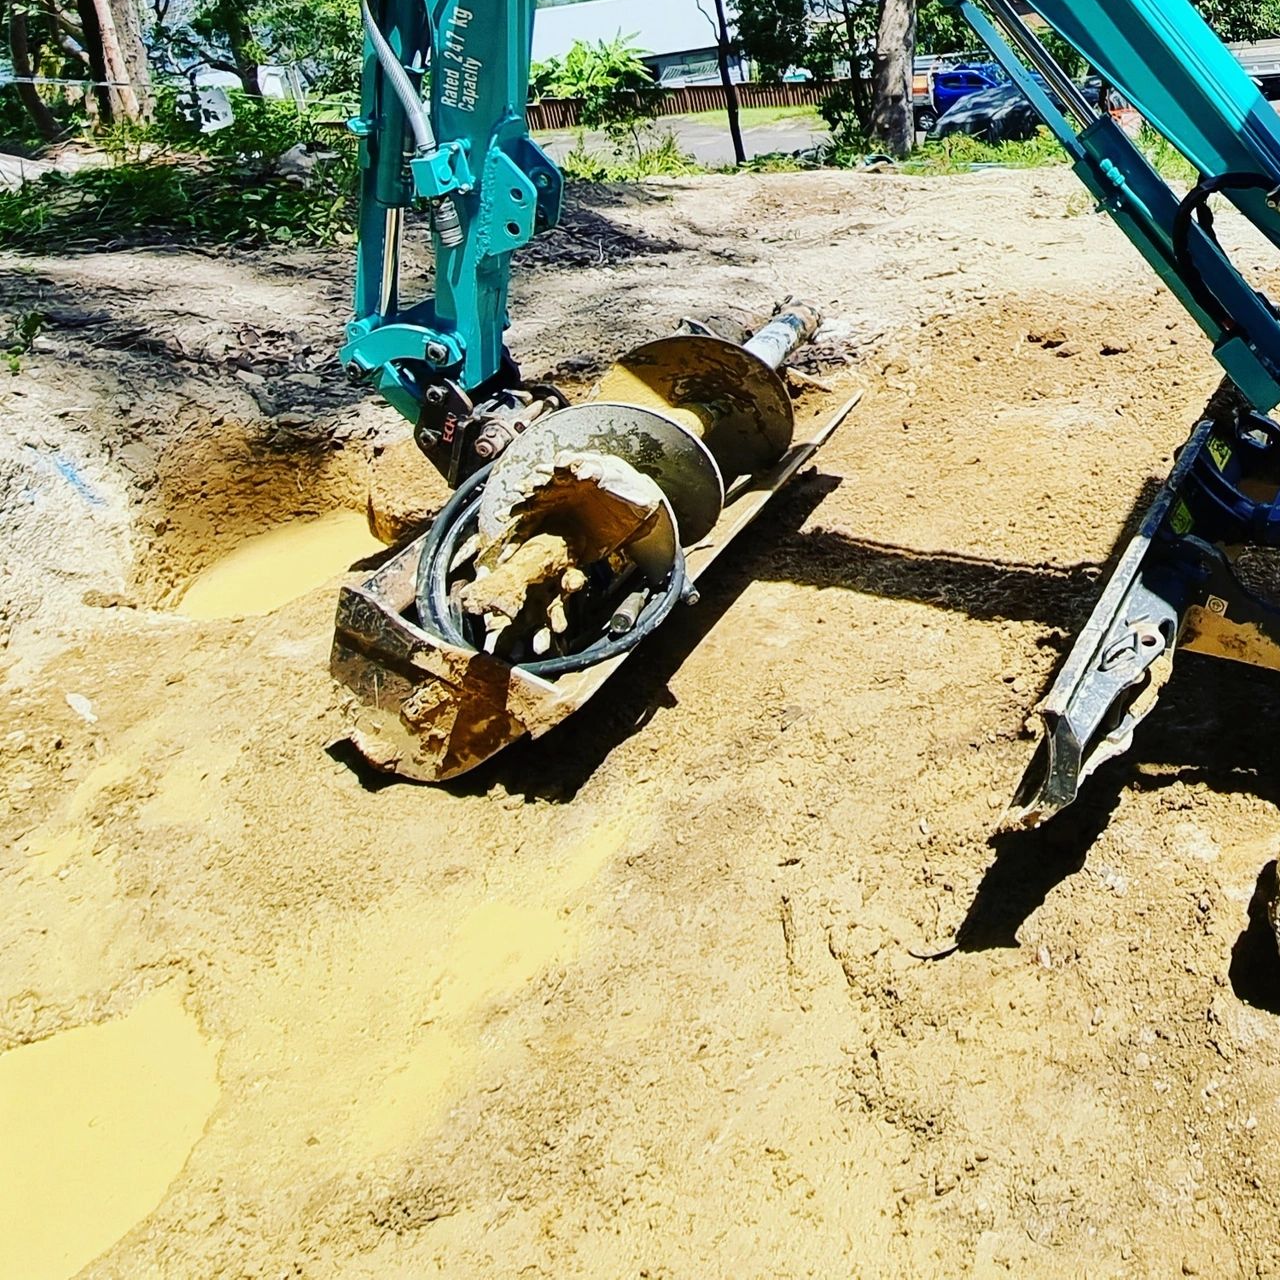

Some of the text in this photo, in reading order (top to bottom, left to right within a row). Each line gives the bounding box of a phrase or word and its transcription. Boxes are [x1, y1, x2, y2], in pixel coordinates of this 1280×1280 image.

[440, 6, 473, 108] Rated 247 kg
[458, 57, 483, 112] Capacity
